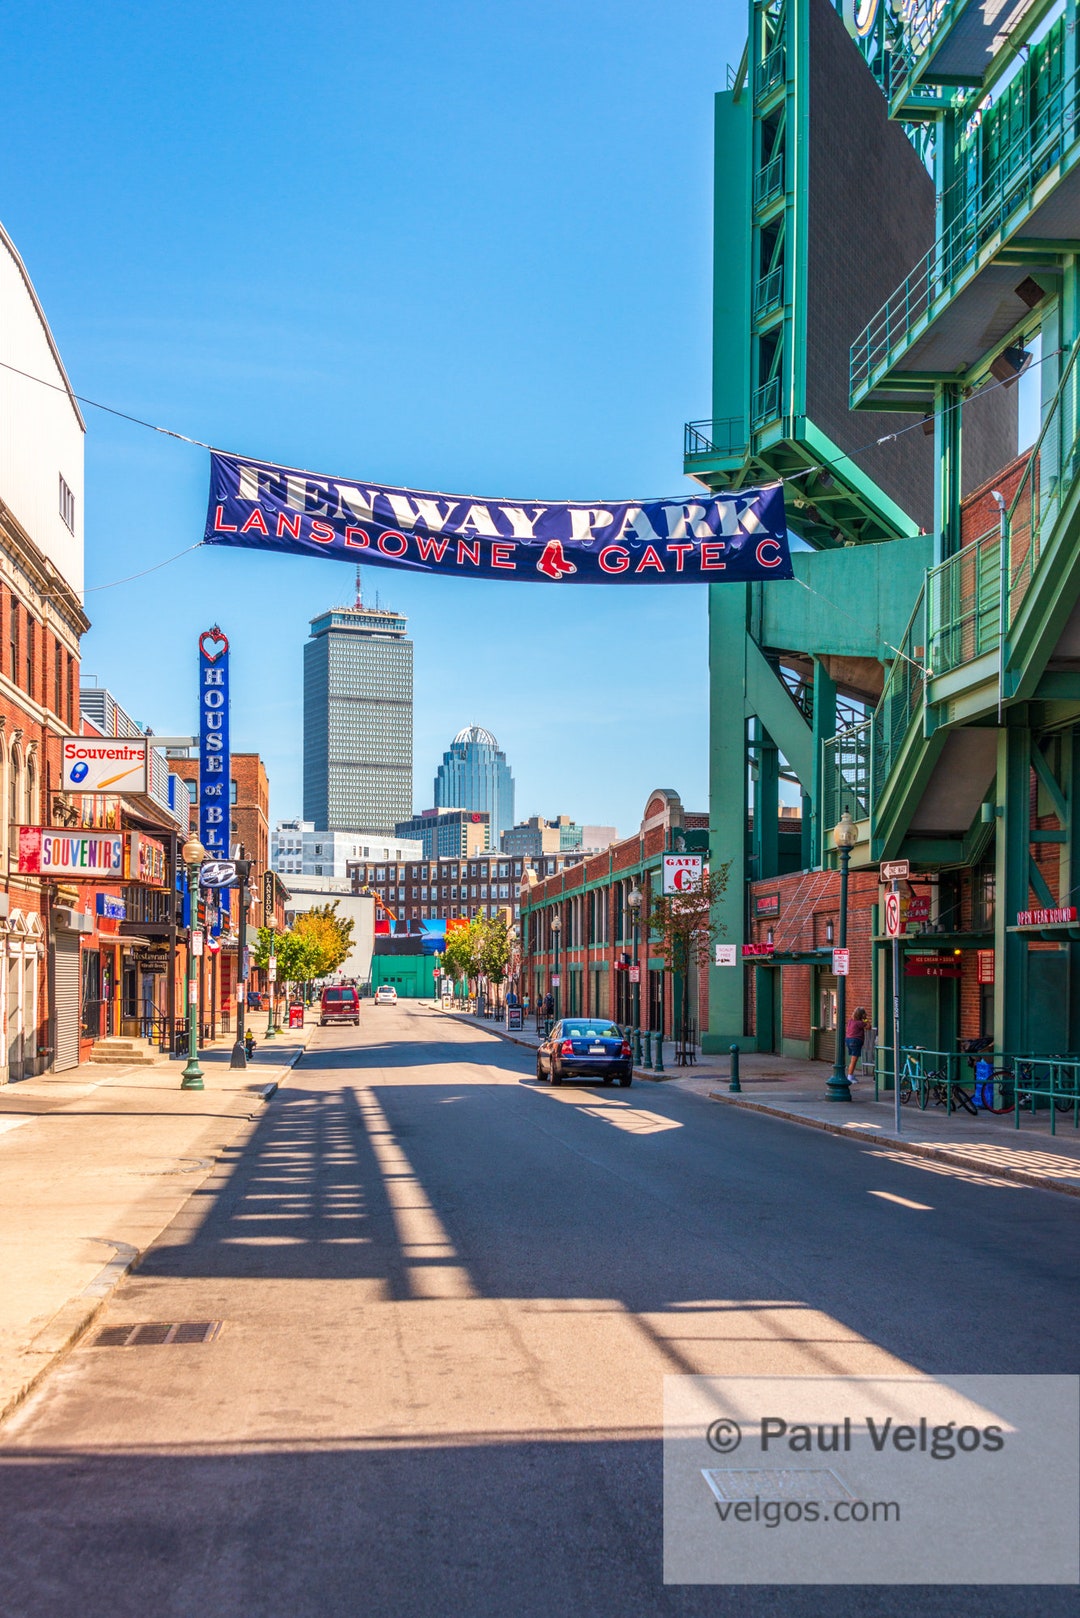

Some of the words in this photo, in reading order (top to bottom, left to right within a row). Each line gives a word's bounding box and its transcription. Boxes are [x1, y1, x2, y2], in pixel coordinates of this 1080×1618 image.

[235, 464, 548, 538] FENWAY
[567, 496, 770, 541] PARK
[213, 505, 517, 569] LANSDOWNE
[598, 542, 727, 573] GATE
[755, 538, 783, 568] C
[204, 667, 224, 773] HOUSE
[64, 743, 145, 761] Souvenirs
[205, 782, 223, 796] of
[43, 837, 121, 869] SOUVENIRS
[665, 858, 700, 866] GATE
[674, 868, 693, 891] C
[1017, 910, 1032, 925] OPEN
[1033, 909, 1049, 924] YEAR
[926, 968, 943, 976] EAT
